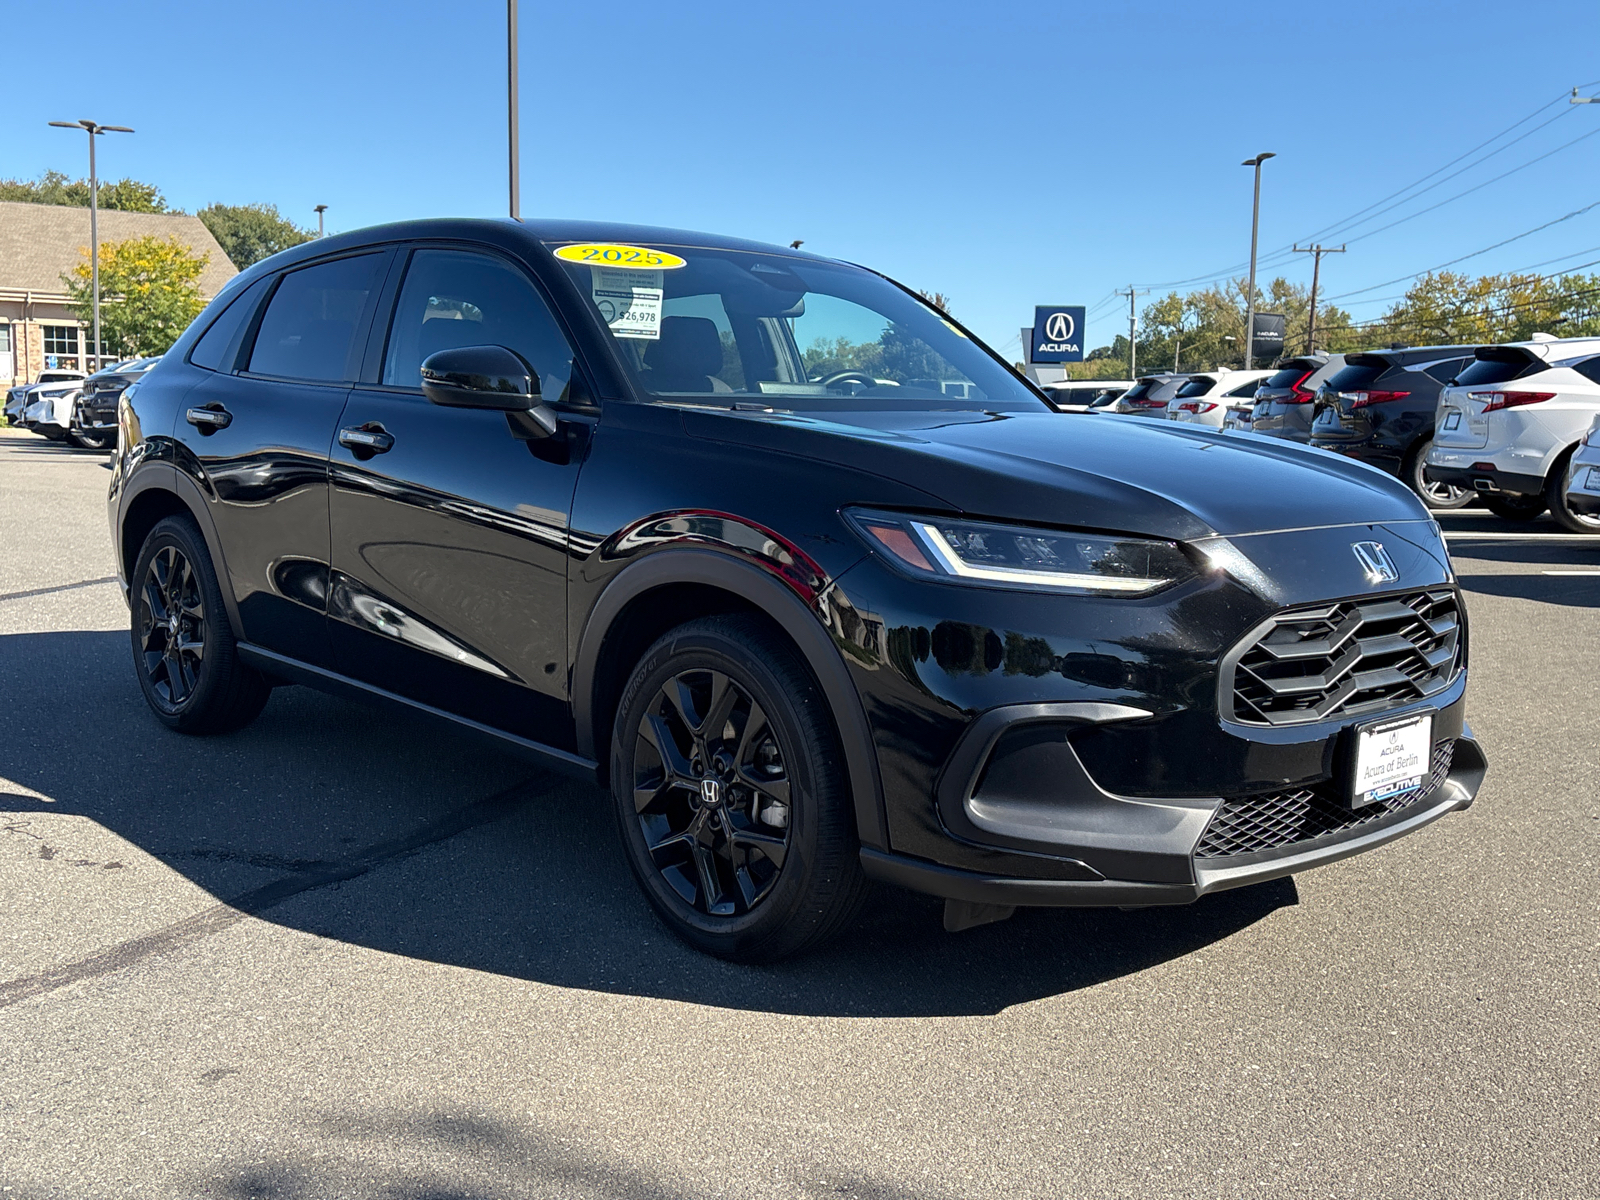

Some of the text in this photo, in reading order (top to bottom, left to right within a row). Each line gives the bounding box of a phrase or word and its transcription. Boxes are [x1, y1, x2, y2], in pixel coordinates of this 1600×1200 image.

[582, 248, 663, 265] 2025
[619, 311, 656, 323] $26,978
[1038, 343, 1080, 352] ACURA
[621, 656, 658, 719] KINERGY GT
[1380, 744, 1405, 757] ACURA
[1363, 765, 1385, 780] Acura
[1386, 759, 1396, 773] of
[1396, 753, 1419, 770] Berlin
